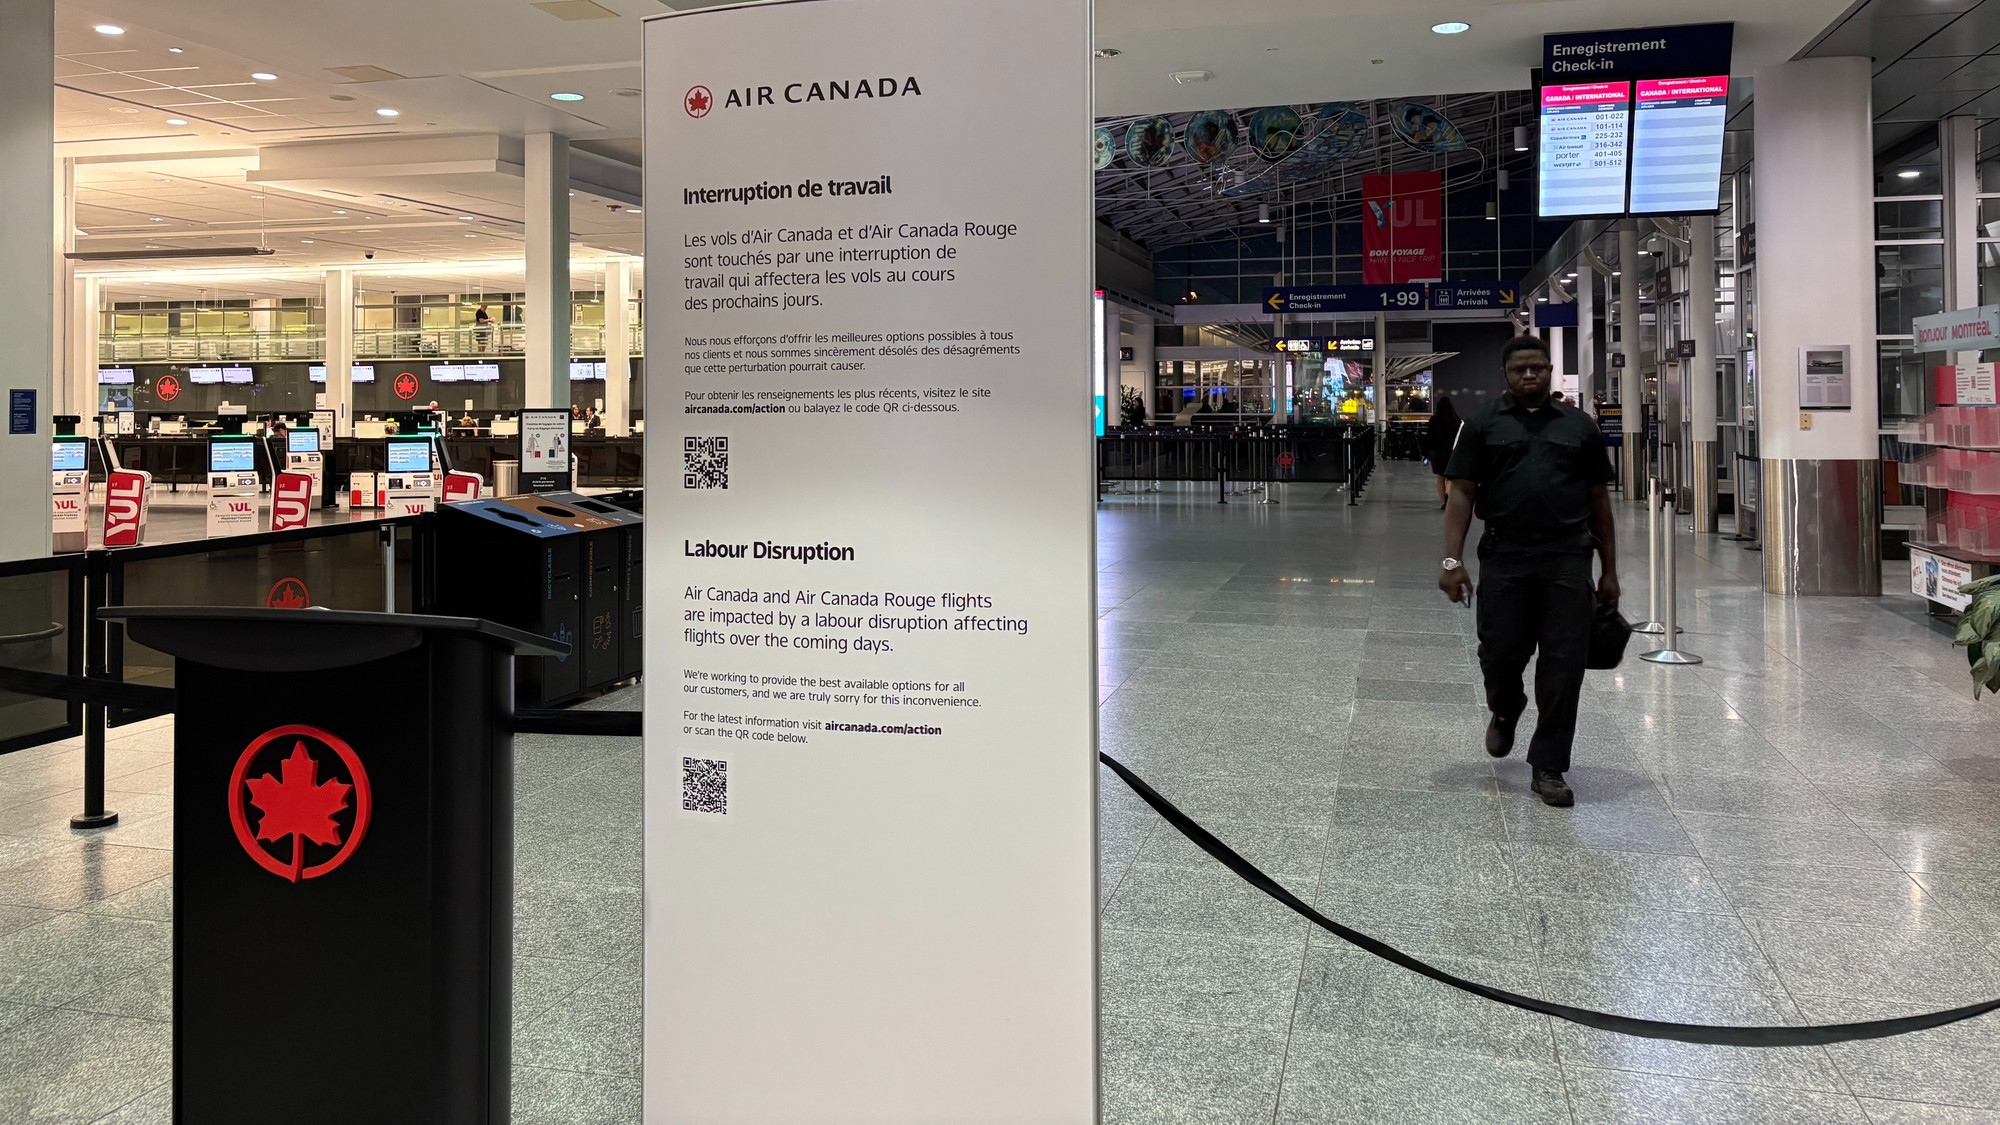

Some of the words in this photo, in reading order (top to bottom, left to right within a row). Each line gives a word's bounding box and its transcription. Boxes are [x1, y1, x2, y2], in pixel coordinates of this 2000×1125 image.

[1553, 38, 1666, 56] Enregistrement
[1552, 58, 1614, 73] Check-in
[724, 86, 775, 109] AIR
[784, 76, 922, 104] CANADA
[1575, 92, 1624, 100] INTERNATIONAL
[1671, 86, 1723, 95] INTERNATIONAL
[1596, 122, 1623, 130] 101-114
[1555, 152, 1580, 160] porter
[683, 180, 793, 206] Interruption
[797, 179, 823, 198] de
[827, 174, 893, 197] travail
[1367, 199, 1436, 228] YUL
[684, 233, 707, 248] Les
[710, 230, 738, 246] vols
[741, 228, 773, 245] d'Air
[777, 226, 833, 243] Canada
[837, 226, 854, 241] et
[858, 224, 894, 240] d'Air
[898, 222, 959, 239] Canada
[964, 222, 1018, 240] Rouge
[684, 254, 713, 269] sont
[716, 249, 772, 267] touchés
[776, 252, 801, 268] par
[805, 250, 834, 264] une
[839, 244, 931, 265] interruption
[936, 244, 957, 260] de
[1369, 249, 1389, 257] BON
[1391, 248, 1425, 256] VOYAGE
[684, 273, 724, 290] travail
[728, 272, 750, 291] qui
[754, 271, 820, 287] affectera
[825, 269, 846, 284] les
[850, 267, 882, 284] vols
[886, 270, 906, 283] au
[911, 269, 955, 282] cours
[1289, 293, 1347, 302] Enregistrement
[1380, 291, 1420, 306] 1-99
[1456, 288, 1491, 296] Arrivées
[684, 295, 708, 311] des
[712, 293, 779, 313] prochains
[782, 292, 823, 311] jours.
[1289, 301, 1322, 309] Check-in
[1456, 297, 1488, 306] Arrivals
[684, 336, 708, 347] Nous
[709, 337, 732, 346] nous
[733, 334, 778, 347] efforçons
[779, 333, 813, 347] d'offrir
[814, 333, 829, 343] les
[831, 332, 884, 343] meilleures
[885, 331, 925, 344] options
[927, 330, 977, 344] possibles
[979, 329, 987, 341] à
[989, 330, 1014, 343] tous
[684, 390, 706, 401] Pour
[707, 389, 740, 401] obtenir
[741, 389, 755, 400] les
[757, 388, 835, 402] renseignements
[837, 388, 852, 399] les
[854, 388, 876, 401] plus
[878, 387, 920, 400] récents,
[922, 387, 957, 398] visitez
[959, 387, 969, 398] le
[971, 387, 991, 398] site
[684, 402, 786, 415] aircanada.com/action
[787, 403, 801, 414] ou
[803, 402, 841, 416] balayez
[843, 402, 853, 413] le
[855, 402, 881, 413] code
[883, 402, 899, 414] QR
[901, 401, 960, 413] ci-dessous.
[54, 500, 78, 509] YUL
[107, 480, 141, 537] YUL
[228, 502, 252, 512] YUL
[684, 539, 749, 559] Labour
[753, 540, 855, 565] Disruption
[683, 585, 703, 601] Air
[706, 586, 758, 603] Canada
[762, 589, 790, 605] and
[794, 589, 817, 605] Air
[820, 590, 879, 607] Canada
[884, 592, 936, 611] Rouge
[940, 592, 993, 612] flights
[683, 609, 706, 622] are
[709, 607, 774, 627] impacted
[778, 610, 797, 630] by
[800, 615, 810, 627] a
[815, 612, 864, 629] labour
[868, 613, 948, 633] disruption
[953, 615, 1028, 636] affecting
[683, 627, 726, 647] flights
[729, 633, 761, 647] over
[763, 632, 789, 648] the
[793, 634, 848, 654] coming
[853, 635, 894, 655] days.
[683, 669, 709, 681] We're
[710, 671, 747, 685] working
[749, 674, 760, 684] to
[761, 674, 798, 687] provide
[799, 676, 817, 688] the
[819, 676, 842, 689] best
[843, 678, 889, 690] available
[891, 680, 932, 692] options
[934, 680, 950, 692] for
[952, 681, 965, 692] all
[683, 710, 699, 721] For
[700, 711, 716, 723] the
[717, 712, 743, 725] latest
[744, 714, 800, 729] information
[801, 719, 823, 731] visit
[824, 720, 942, 736] aircanada.com/action
